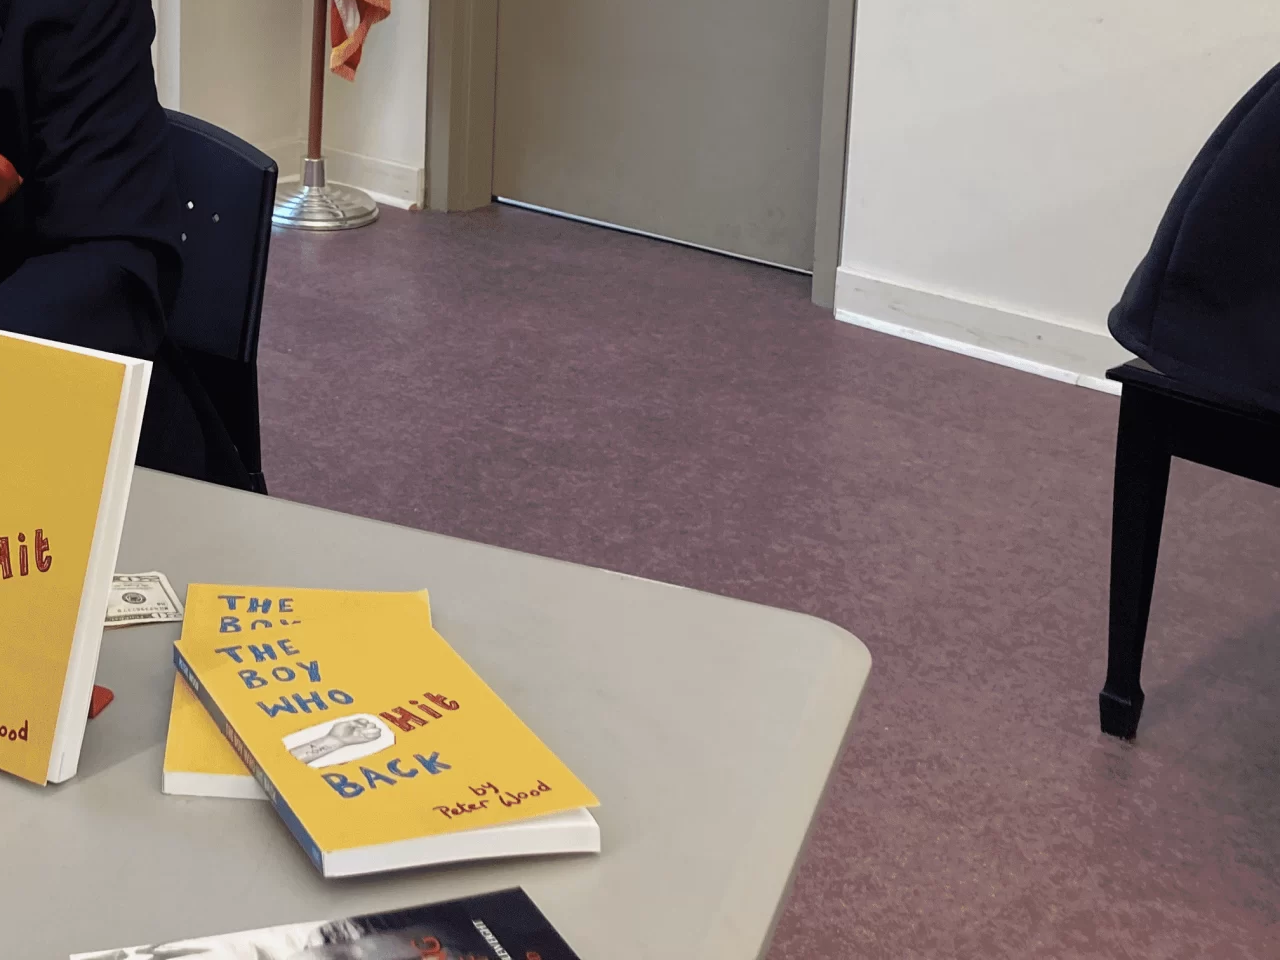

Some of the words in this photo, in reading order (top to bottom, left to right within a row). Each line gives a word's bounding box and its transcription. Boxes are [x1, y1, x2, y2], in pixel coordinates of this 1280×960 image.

[217, 595, 295, 614] THE
[214, 638, 301, 664] THE
[237, 660, 322, 690] BOY
[256, 688, 355, 719] WHO
[378, 691, 461, 733] Hit
[320, 751, 452, 800] BACK
[468, 781, 500, 798] by
[432, 799, 490, 820] Peter
[498, 779, 553, 809] Wood
